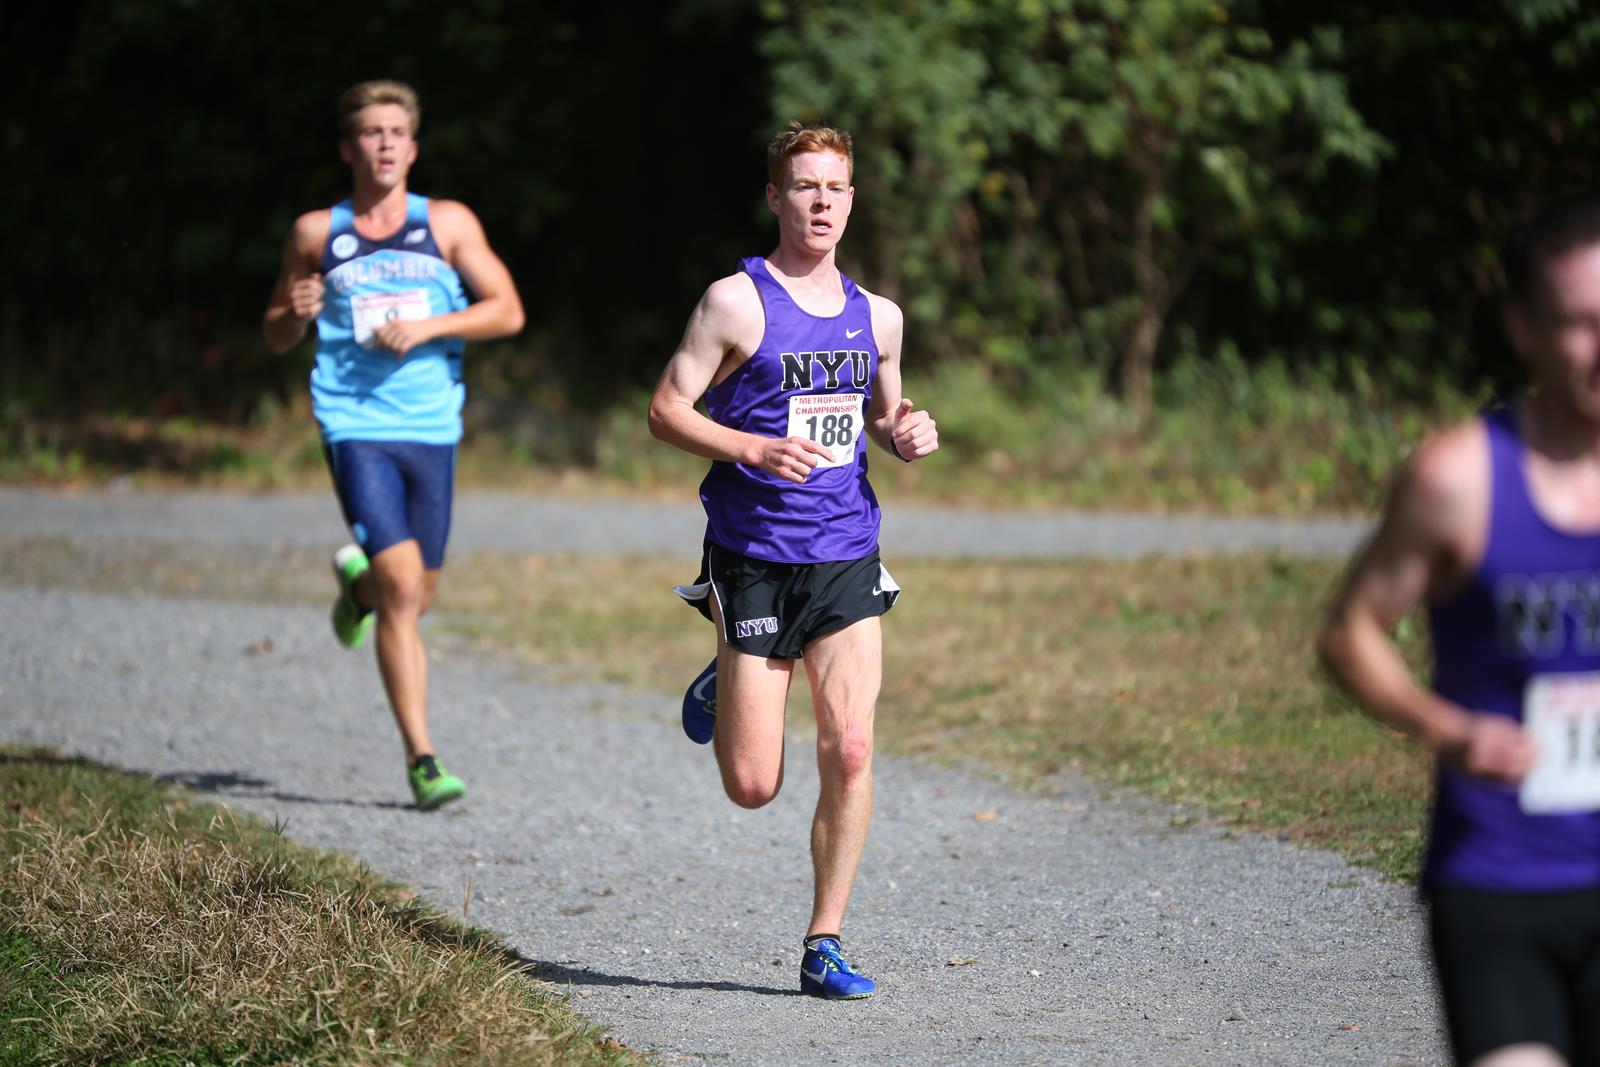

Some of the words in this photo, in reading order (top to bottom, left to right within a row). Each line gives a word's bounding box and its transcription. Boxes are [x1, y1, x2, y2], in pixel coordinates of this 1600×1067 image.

[781, 350, 871, 391] NYU
[796, 404, 858, 415] CHAMPIONSHIPS
[799, 395, 858, 405] METROPOLITAN
[806, 414, 853, 447] 188
[735, 616, 779, 638] NYU
